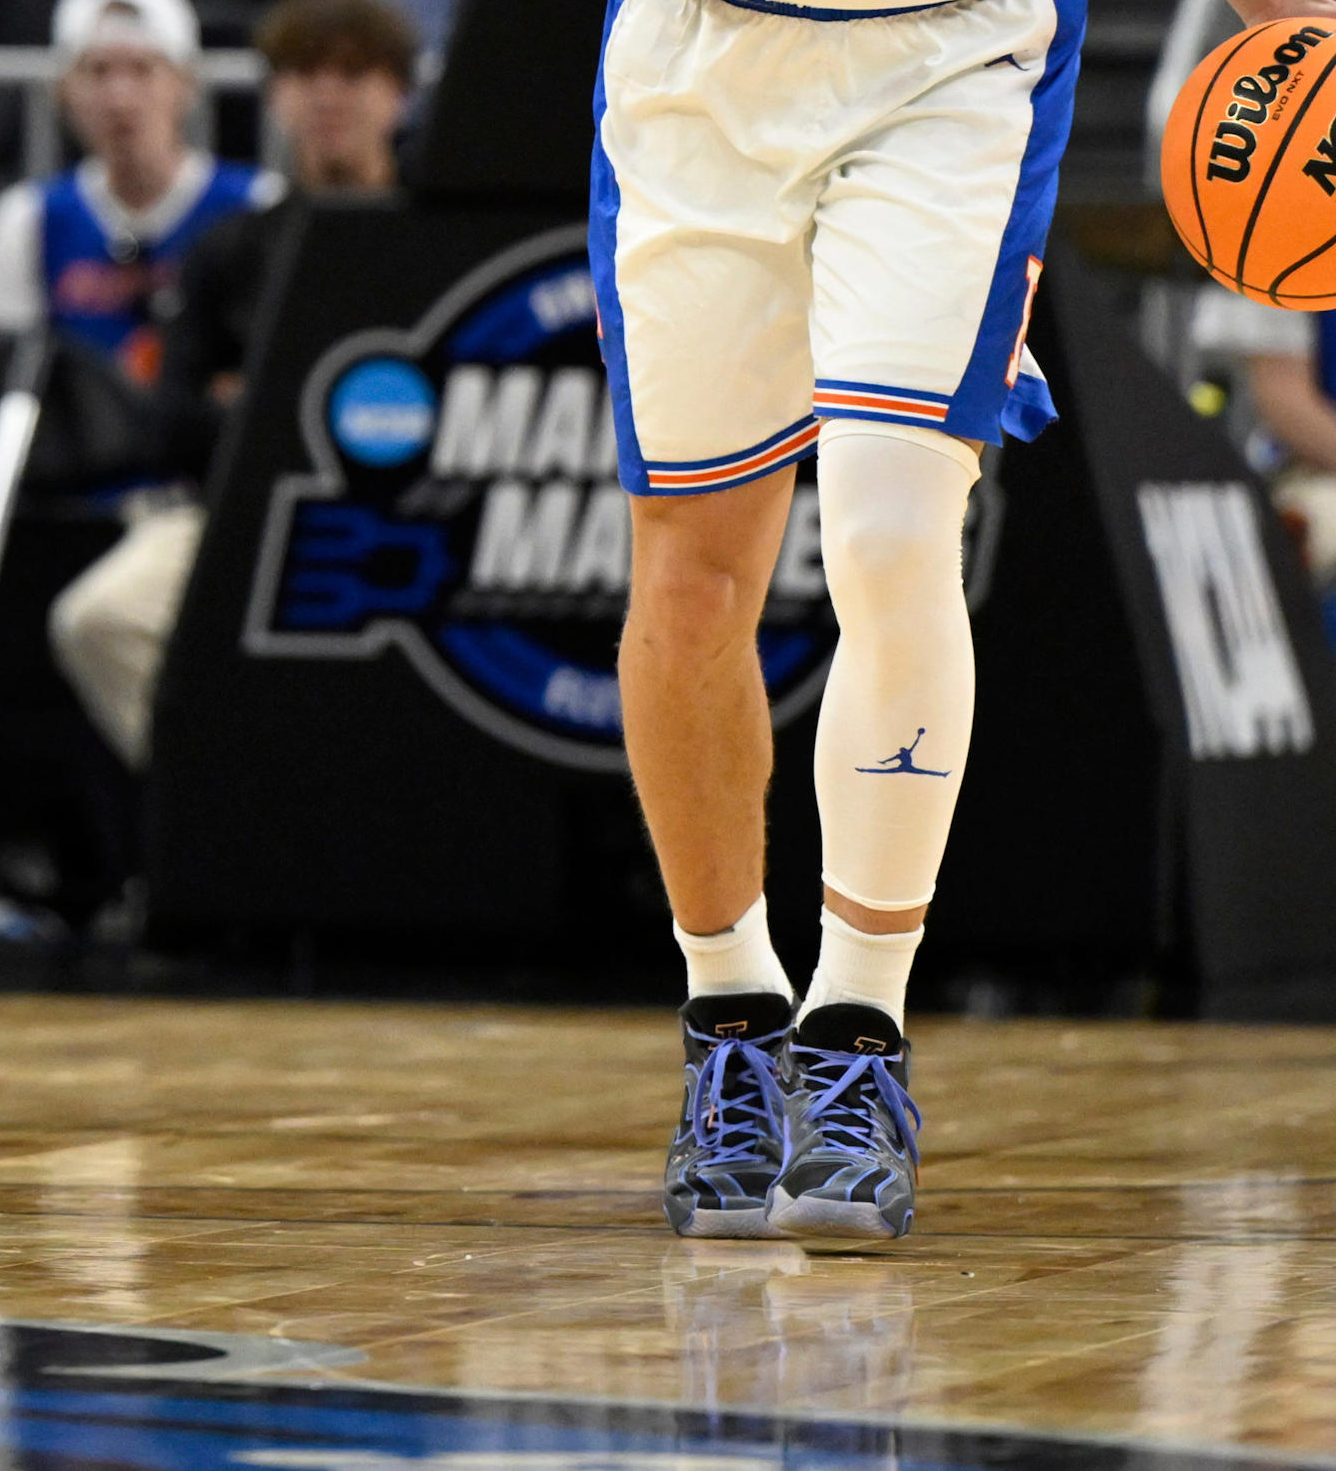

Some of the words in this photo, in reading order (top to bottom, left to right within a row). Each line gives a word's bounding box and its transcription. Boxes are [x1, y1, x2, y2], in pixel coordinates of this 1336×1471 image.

[1206, 26, 1335, 184] Wilson
[1272, 96, 1289, 121] EVO
[1286, 70, 1305, 93] NXT
